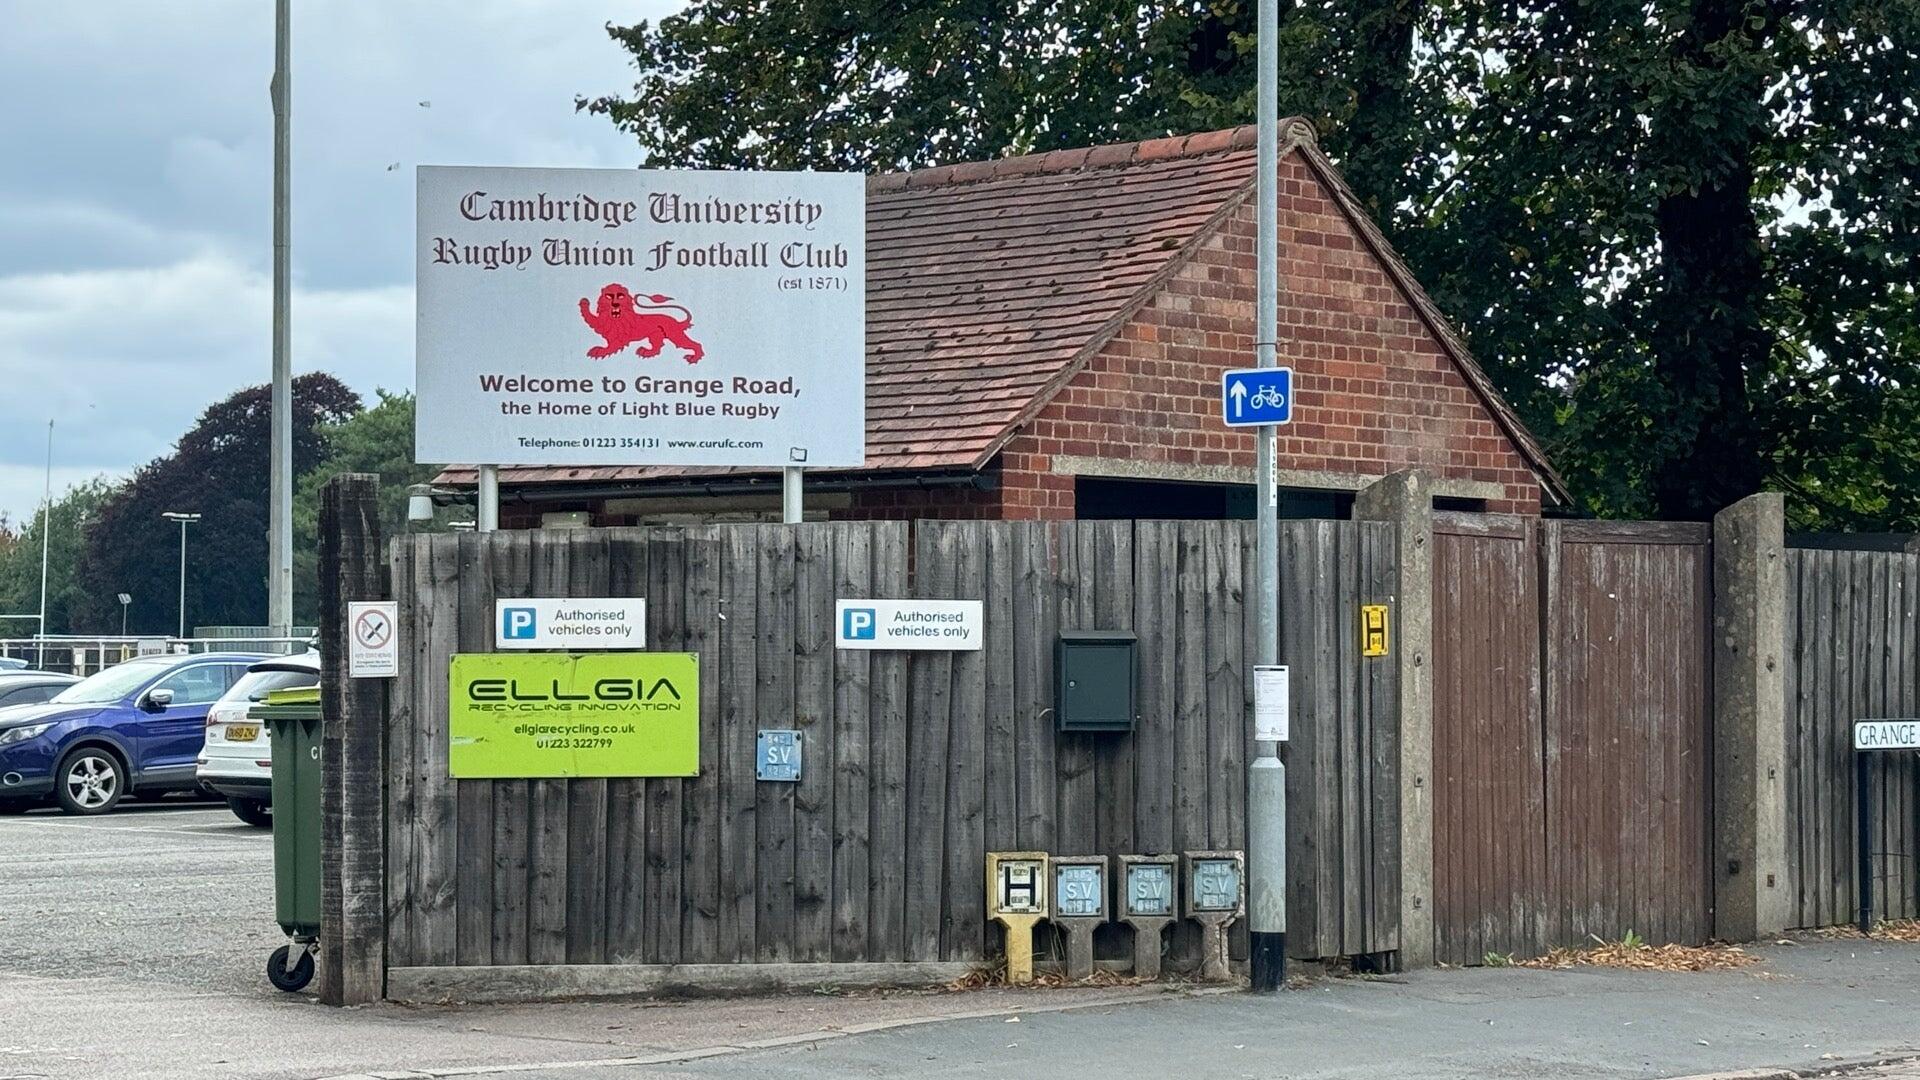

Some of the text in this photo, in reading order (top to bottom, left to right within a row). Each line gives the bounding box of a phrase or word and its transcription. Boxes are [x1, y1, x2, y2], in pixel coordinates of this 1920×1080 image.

[459, 190, 823, 231] Cambridge University
[432, 236, 848, 272] Rugby Union Football Club
[777, 276, 848, 291] (est 1871)
[479, 374, 802, 398] Welcome to Grange Road,
[501, 400, 780, 420] the Home of Light Blue Rugby
[517, 437, 764, 450] Telephone: 01223 354131 www.curufc.com
[554, 609, 625, 621] Authorised
[893, 610, 964, 623] Authorised
[548, 623, 632, 638] vehicles only
[887, 625, 970, 640] vehicles only
[1365, 611, 1385, 650] H
[468, 678, 681, 701] ELLGIA
[468, 703, 681, 712] RECYCLING INNOVATION
[514, 723, 636, 736] ellgiarecycling.co.uk
[1858, 724, 1916, 746] GRANGE
[536, 738, 613, 749] 01223 322799
[767, 746, 791, 764] SV
[1004, 866, 1036, 907] H
[1066, 881, 1093, 899] SV
[1137, 880, 1164, 899] SV
[1203, 876, 1229, 894] SV
